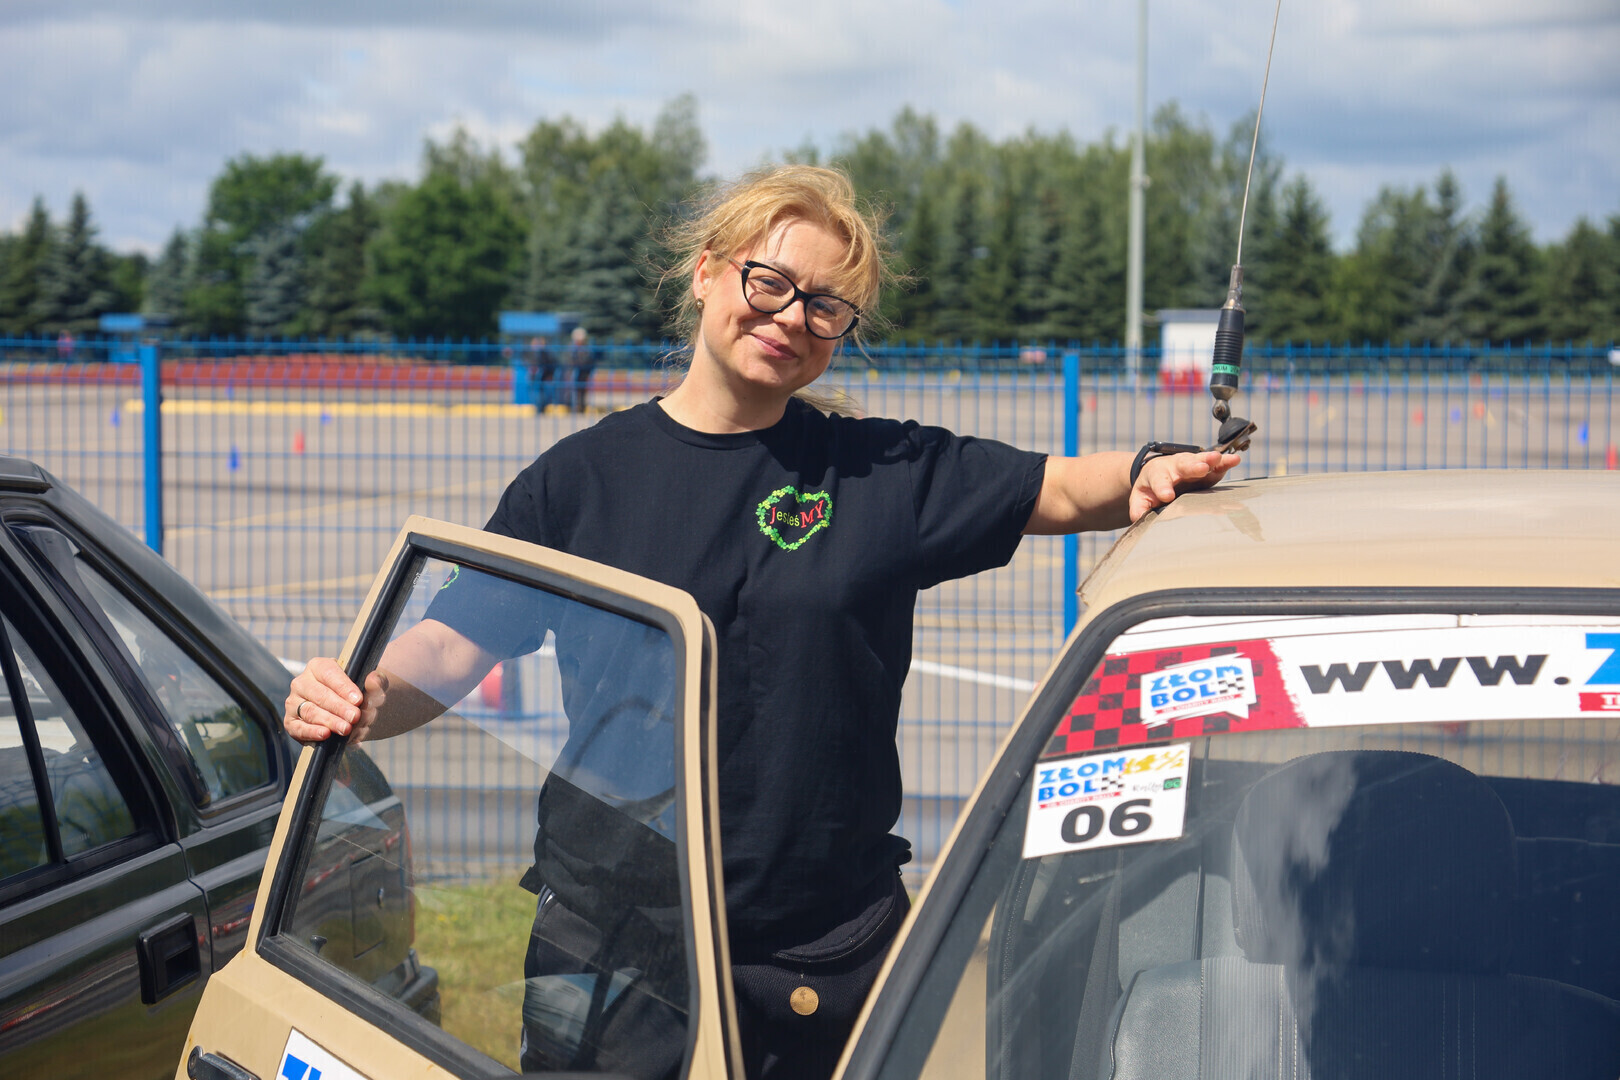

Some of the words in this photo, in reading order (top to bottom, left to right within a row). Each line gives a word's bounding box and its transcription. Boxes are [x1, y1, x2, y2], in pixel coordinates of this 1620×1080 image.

[1150, 665, 1243, 693] ZŁOM
[1150, 683, 1217, 708] BOL
[1039, 757, 1126, 785] ZŁOM
[1038, 780, 1098, 802] BOL
[1061, 798, 1153, 844] 06
